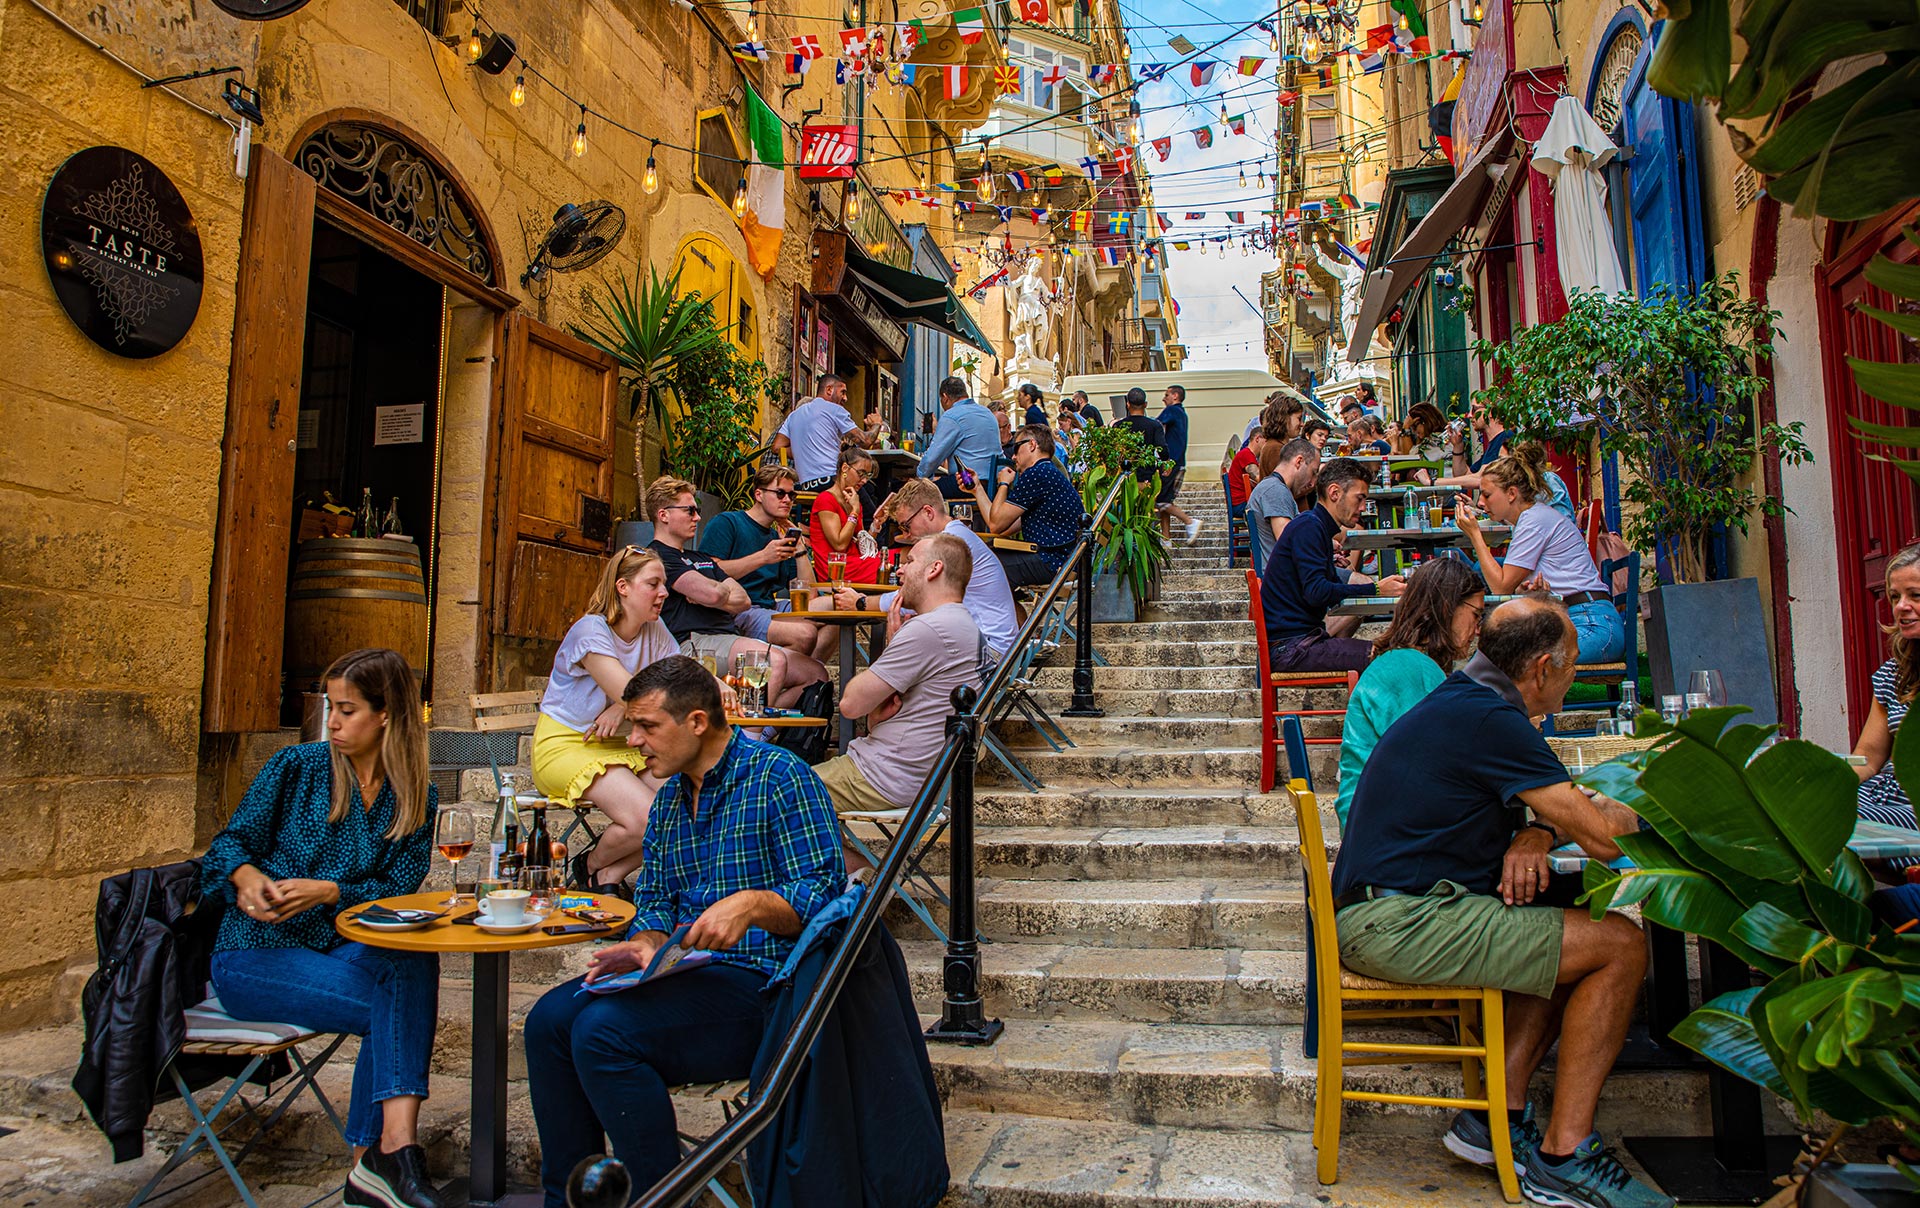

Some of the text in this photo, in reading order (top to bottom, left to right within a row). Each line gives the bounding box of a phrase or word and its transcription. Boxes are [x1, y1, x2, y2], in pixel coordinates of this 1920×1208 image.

[804, 132, 853, 174] illy
[1485, 175, 1509, 225] PIZZERIA
[88, 224, 167, 273] TASTE
[801, 476, 831, 491] UGO
